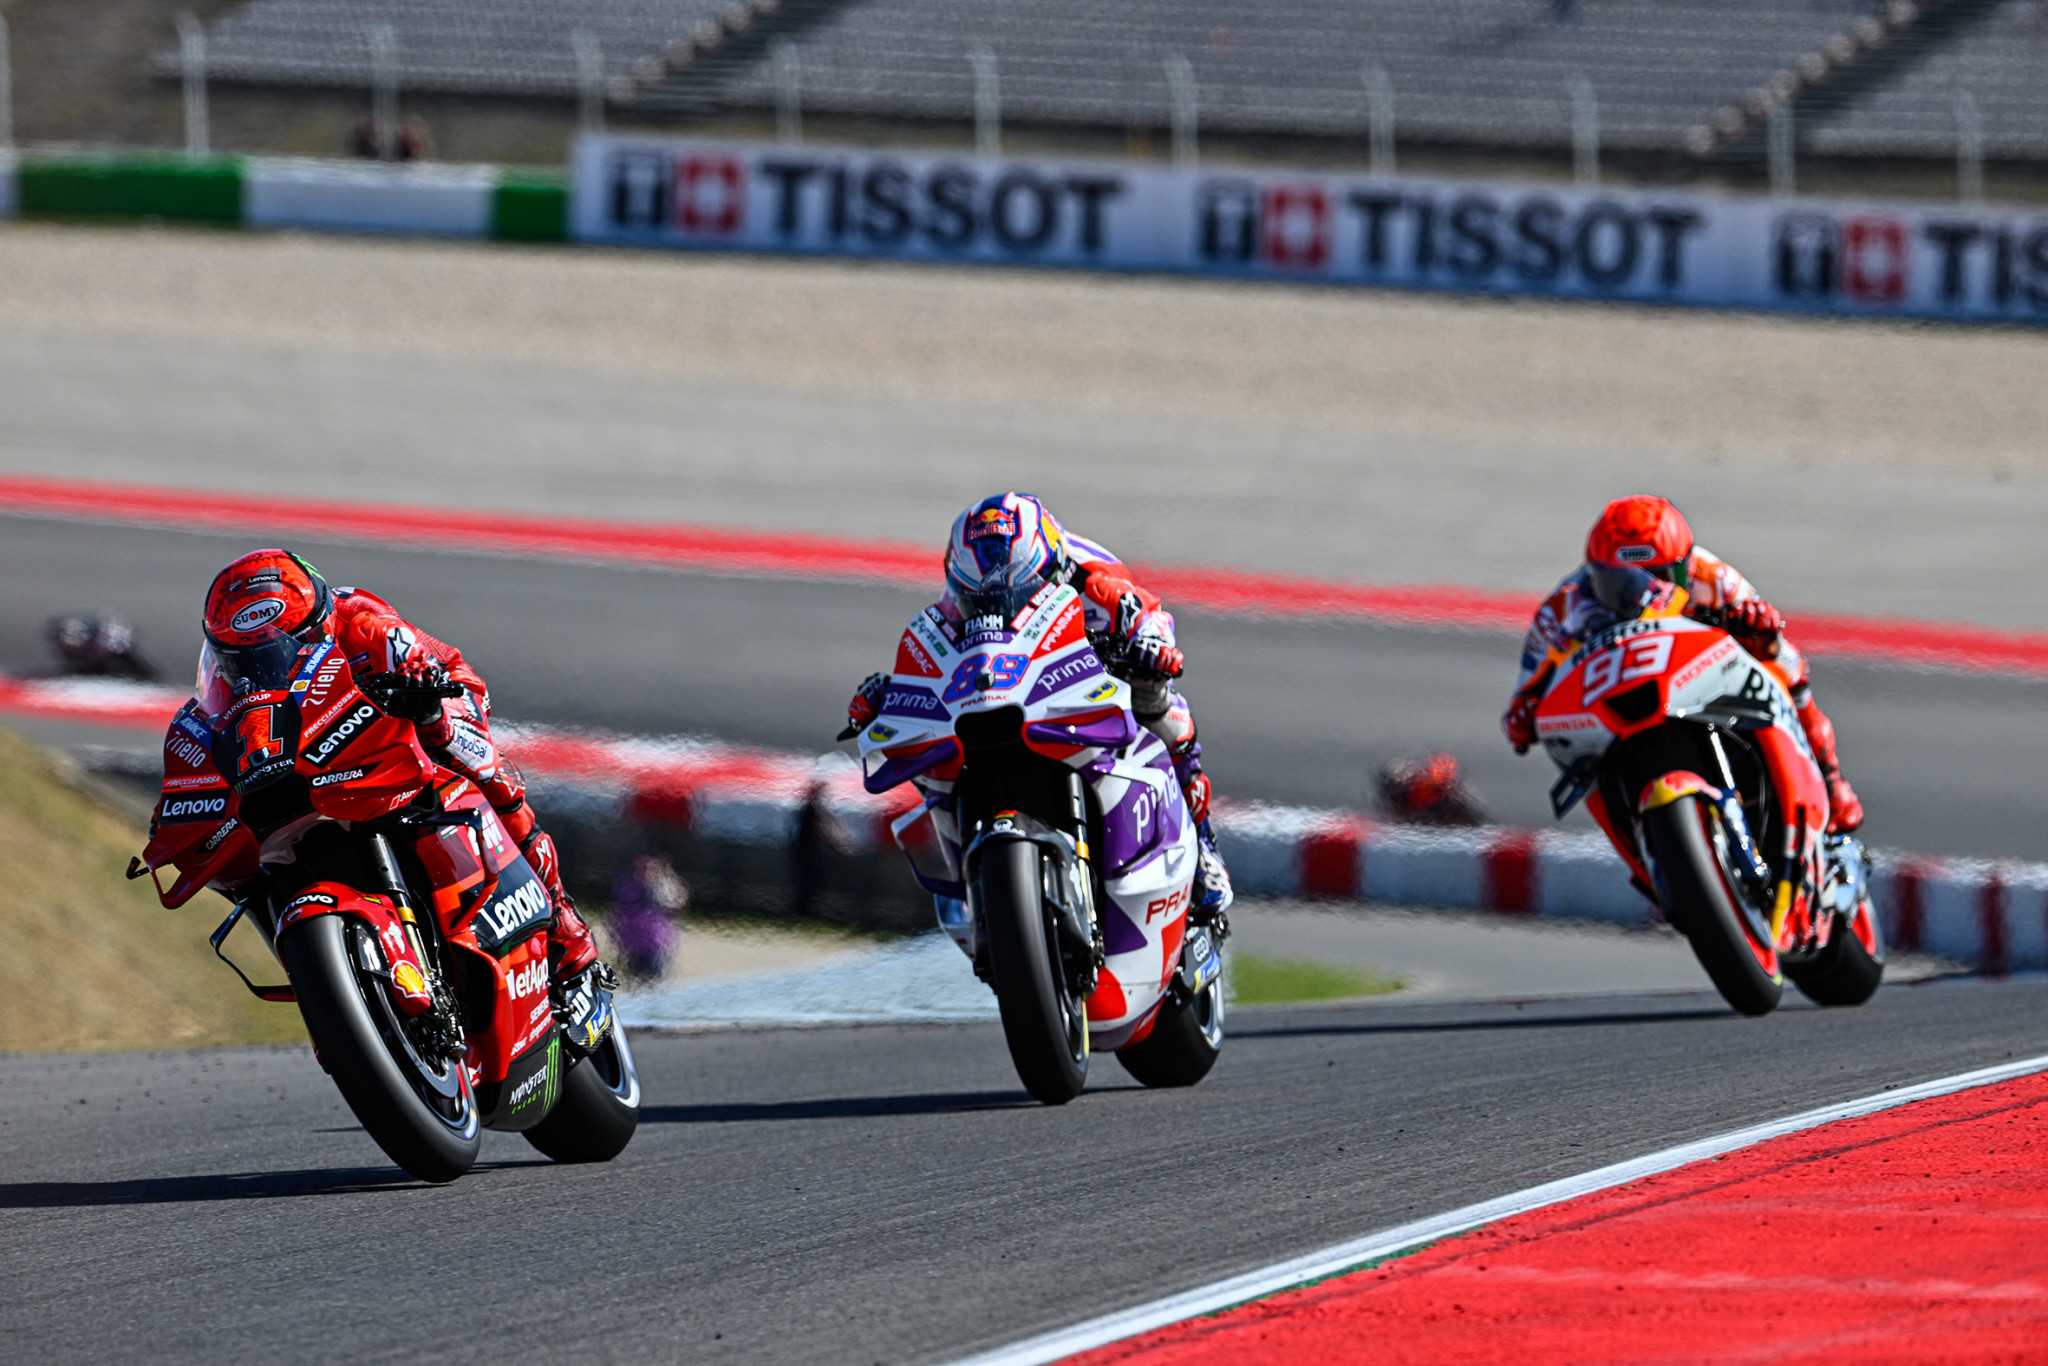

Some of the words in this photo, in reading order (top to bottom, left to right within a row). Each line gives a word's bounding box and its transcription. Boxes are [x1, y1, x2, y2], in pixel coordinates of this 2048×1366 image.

[760, 159, 1124, 252] TISSOT
[1349, 189, 1705, 287] TISSOT
[969, 525, 989, 540] Red
[991, 522, 1015, 536] Bull
[248, 575, 278, 583] Lenovo
[235, 605, 280, 625] SUOMY
[965, 614, 1004, 637] FIAMM
[1040, 604, 1081, 652] PRAMAC
[961, 631, 1004, 651] prima
[942, 653, 1032, 704] 89
[1037, 653, 1099, 691] prima
[1582, 635, 1675, 708] 93
[1673, 643, 1739, 691] HONDA
[303, 689, 358, 739] FRECCIAROSSA
[882, 692, 938, 711] prima
[236, 704, 284, 777] 1
[305, 705, 374, 764] Lenovo
[1538, 718, 1596, 733] HONDA
[312, 769, 364, 787] CARRERA
[162, 798, 226, 817] Lenovo
[205, 817, 239, 850] CARRERA
[480, 878, 546, 940] Lenovo
[509, 1065, 547, 1105] MONSTER
